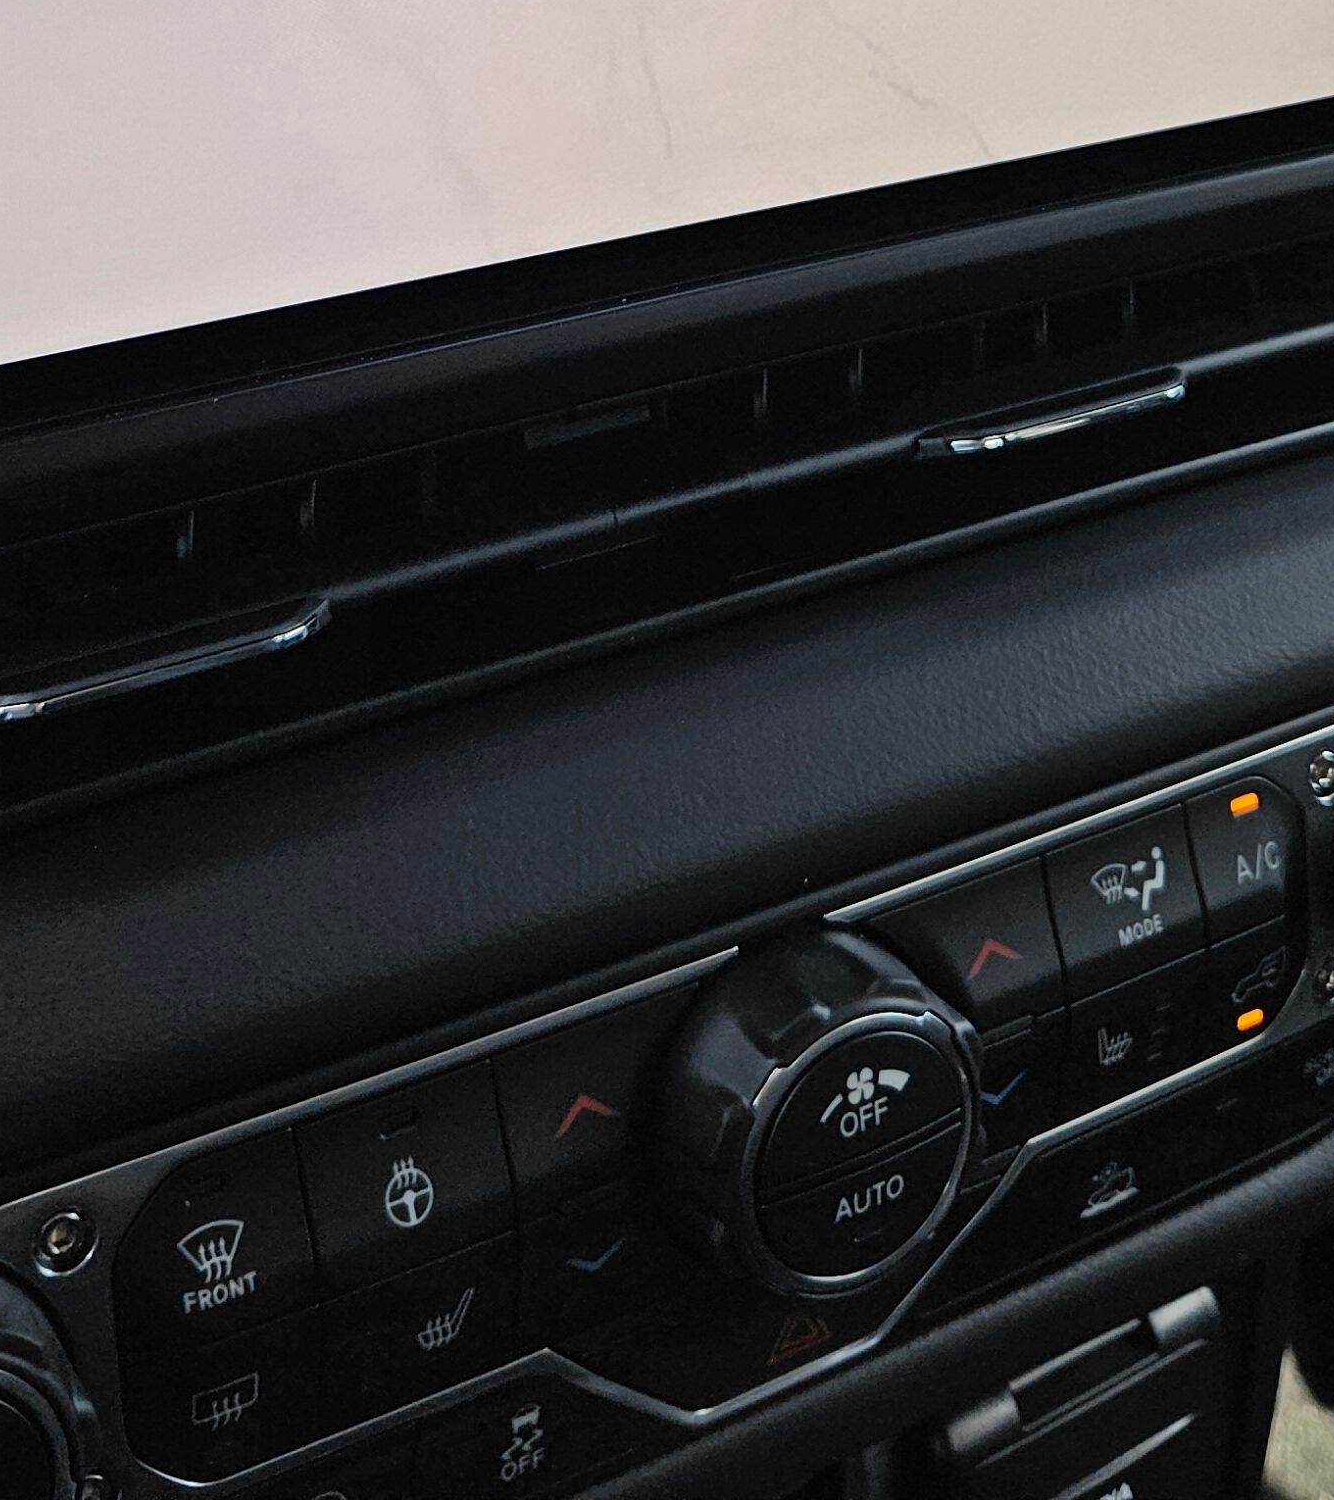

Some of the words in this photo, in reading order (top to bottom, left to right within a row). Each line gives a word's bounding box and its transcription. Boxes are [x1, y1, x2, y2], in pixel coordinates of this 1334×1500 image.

[1236, 840, 1281, 886] A/C
[1117, 913, 1164, 947] MODE
[839, 1094, 889, 1139] OFF
[834, 1174, 905, 1223] AUTO
[183, 1270, 257, 1314] FRONT
[500, 1445, 546, 1482] OFF
